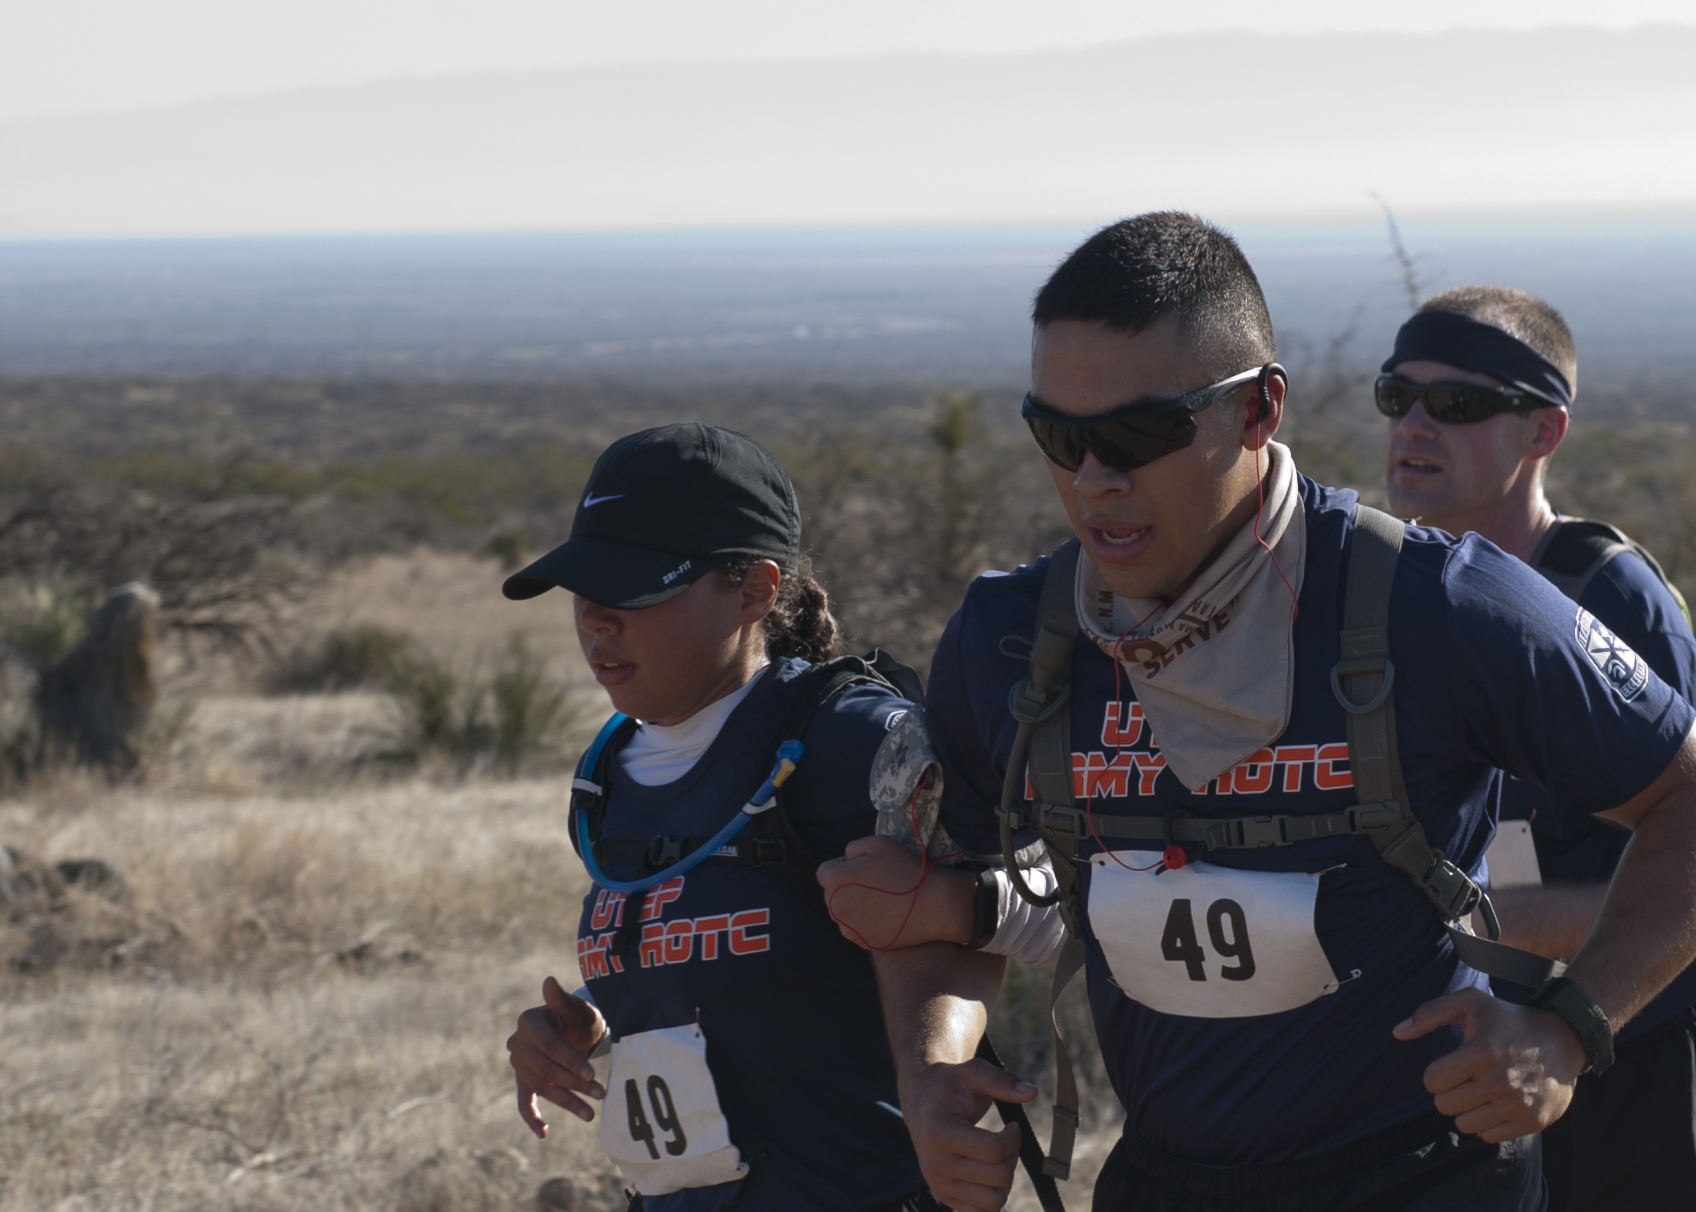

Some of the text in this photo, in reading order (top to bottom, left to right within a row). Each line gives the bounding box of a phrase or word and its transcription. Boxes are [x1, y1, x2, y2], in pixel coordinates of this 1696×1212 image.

[662, 560, 692, 585] DRI-FIT
[638, 907, 771, 969] ROTC
[1160, 897, 1256, 982] 49
[625, 1074, 688, 1160] 49
